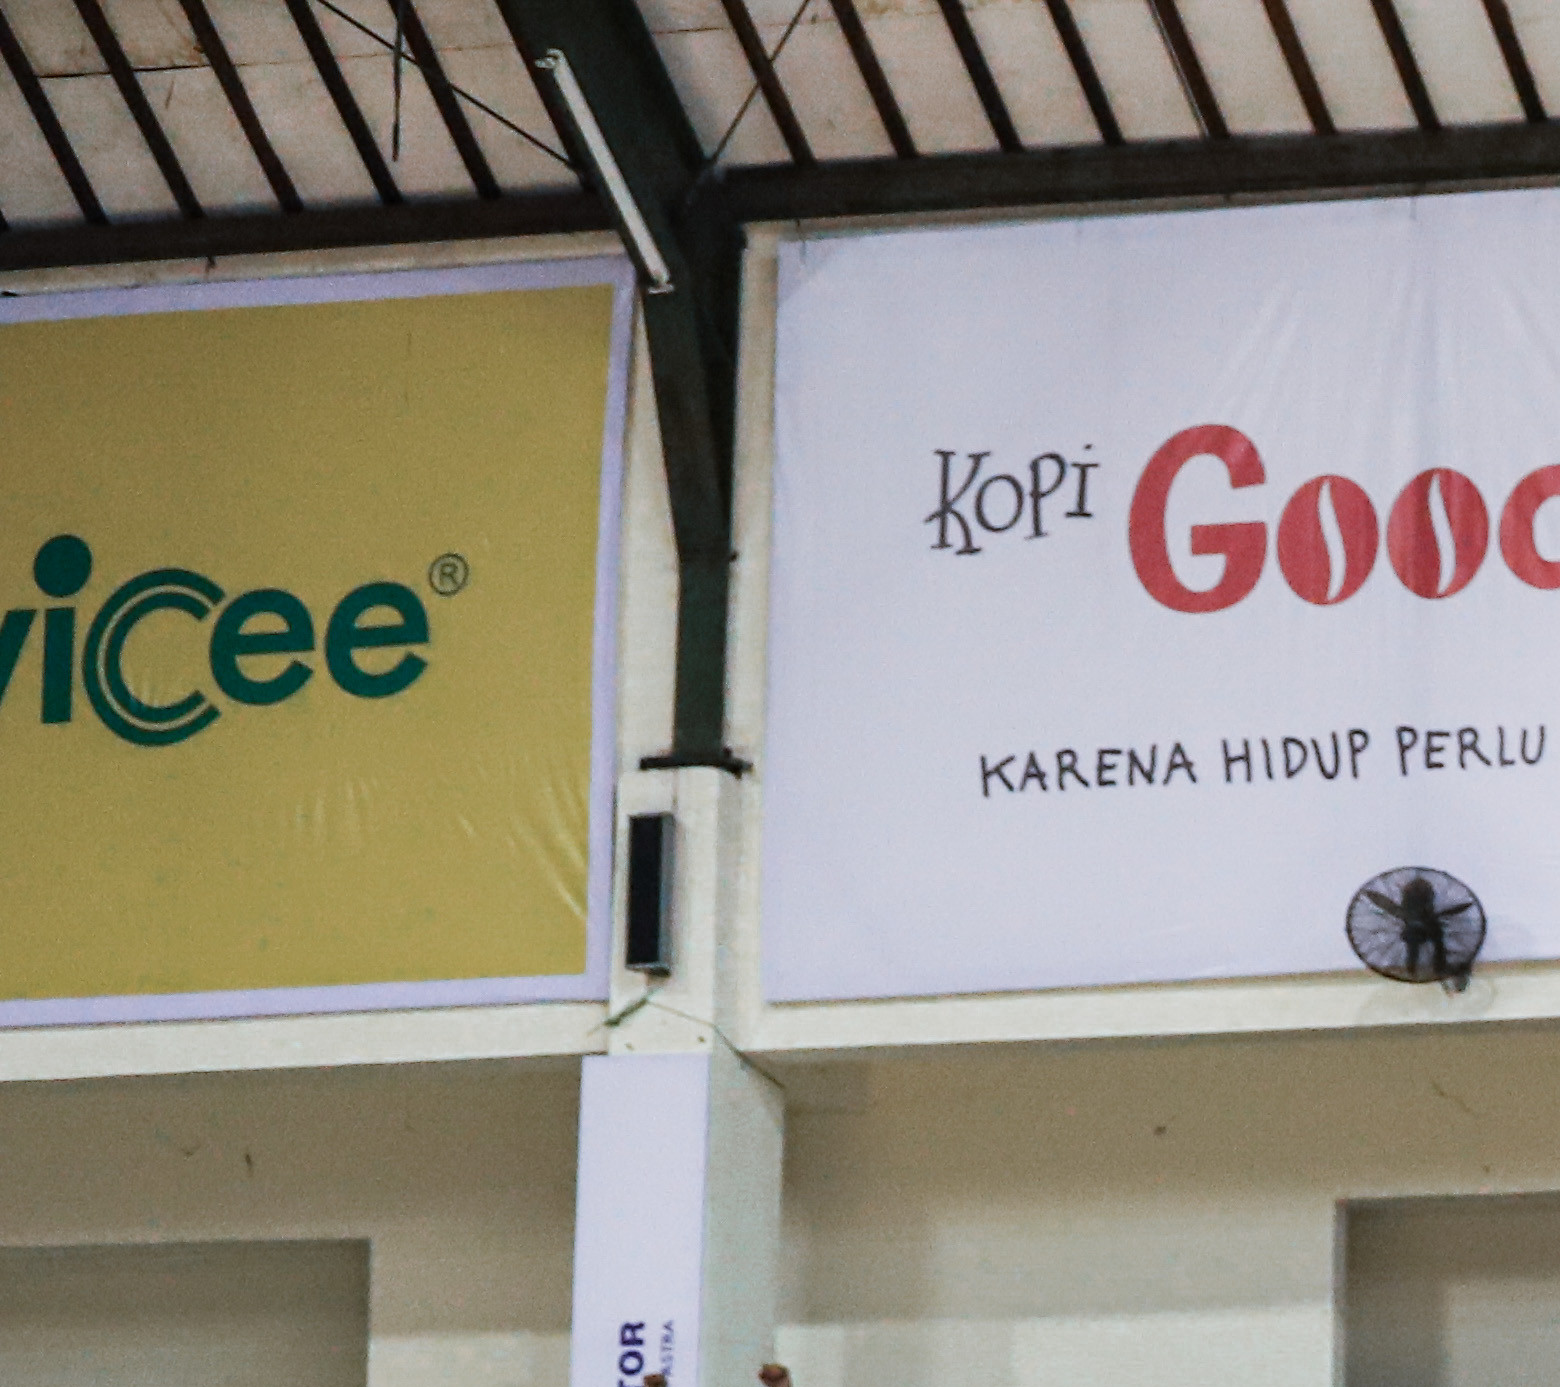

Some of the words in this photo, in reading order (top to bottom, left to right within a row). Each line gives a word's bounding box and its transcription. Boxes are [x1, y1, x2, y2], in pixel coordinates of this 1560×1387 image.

[979, 742, 1197, 798] KARENA
[1222, 728, 1369, 783] HIDUP
[1396, 722, 1545, 776] PERLU
